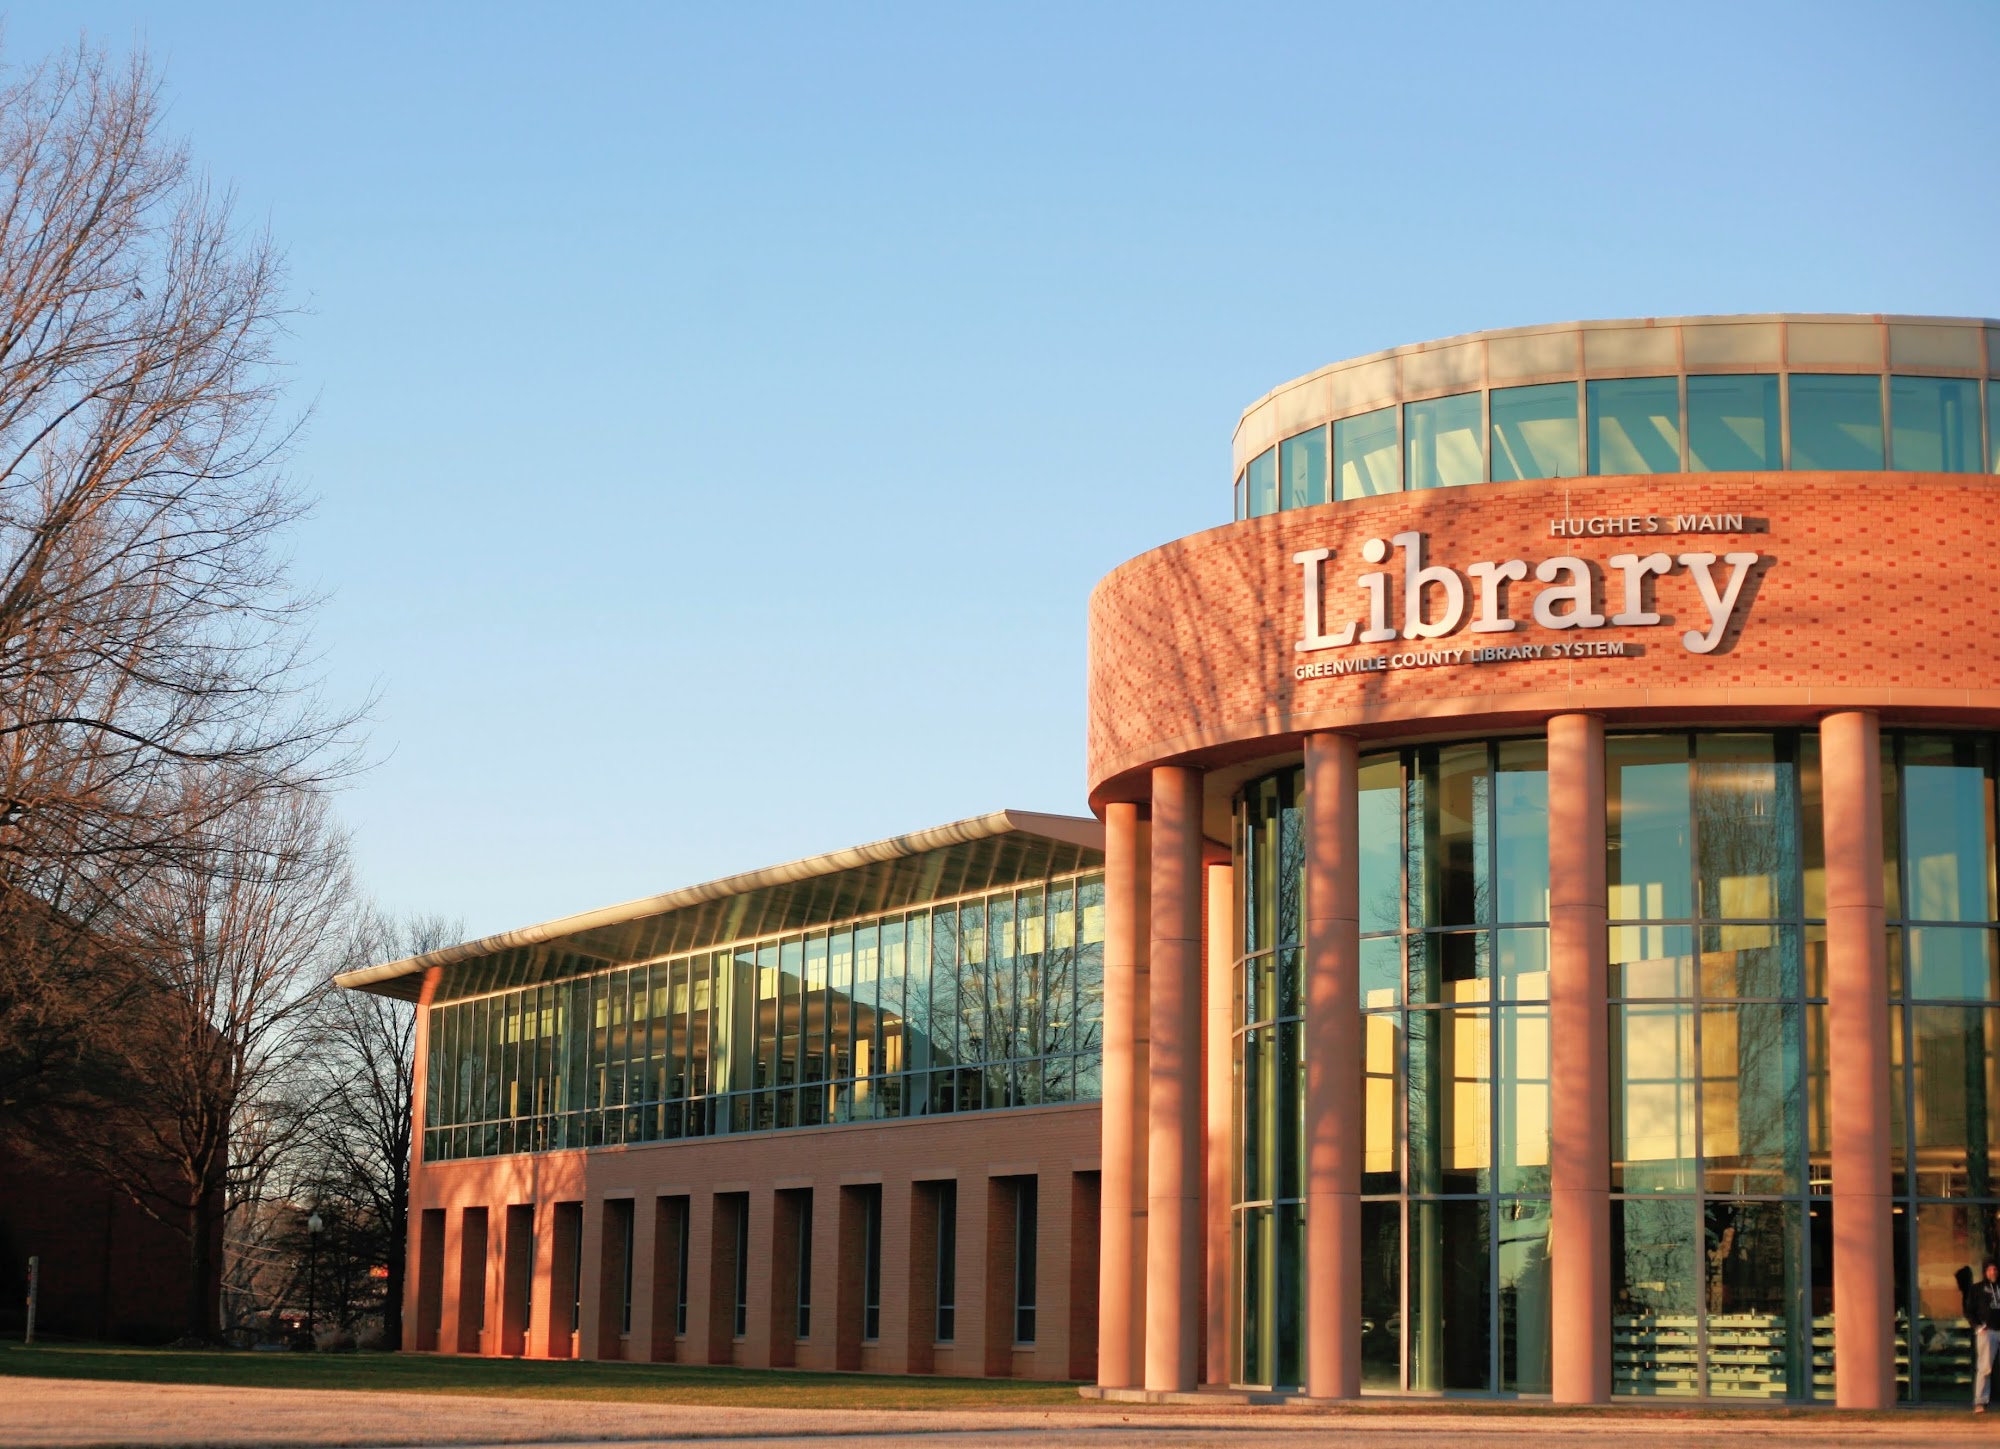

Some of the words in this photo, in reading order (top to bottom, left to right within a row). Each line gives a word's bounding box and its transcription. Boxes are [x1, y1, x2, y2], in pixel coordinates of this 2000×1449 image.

[1550, 515, 1659, 537] HUGHES
[1676, 513, 1743, 531] MAIN
[1292, 530, 1760, 655] Library
[1294, 655, 1387, 680] GREENVILLE
[1391, 649, 1465, 668] COUNTY
[1470, 644, 1545, 662] LIBRARY
[1551, 641, 1625, 657] SYSTEM
